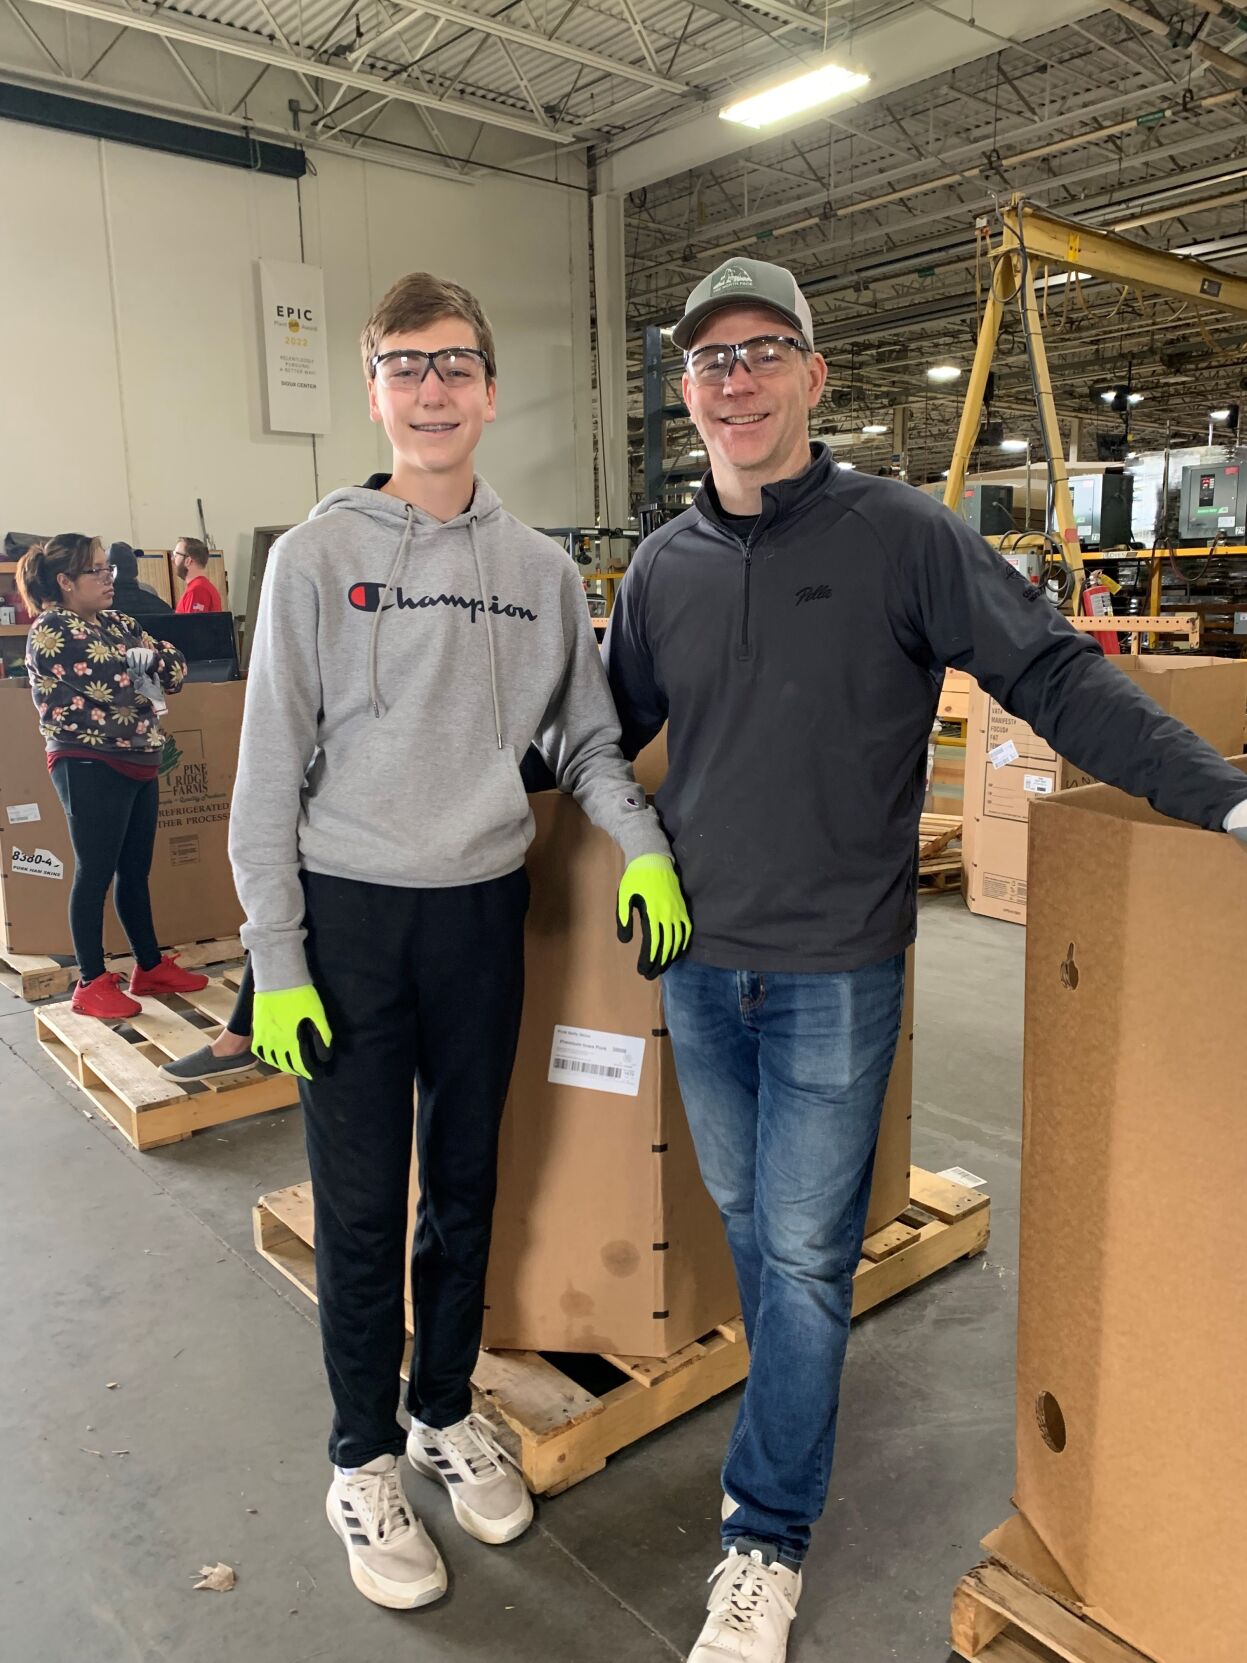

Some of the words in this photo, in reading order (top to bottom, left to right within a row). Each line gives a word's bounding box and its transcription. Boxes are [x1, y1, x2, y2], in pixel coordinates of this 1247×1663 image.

[276, 305, 312, 321] EPIC
[285, 336, 308, 346] 2022
[347, 582, 538, 623] Champion
[991, 717, 1017, 725] MANIFEST#
[990, 726, 1009, 734] FOCUS#
[183, 763, 207, 776] PINE
[175, 774, 208, 788] RIDGE
[173, 784, 208, 796] FARMS
